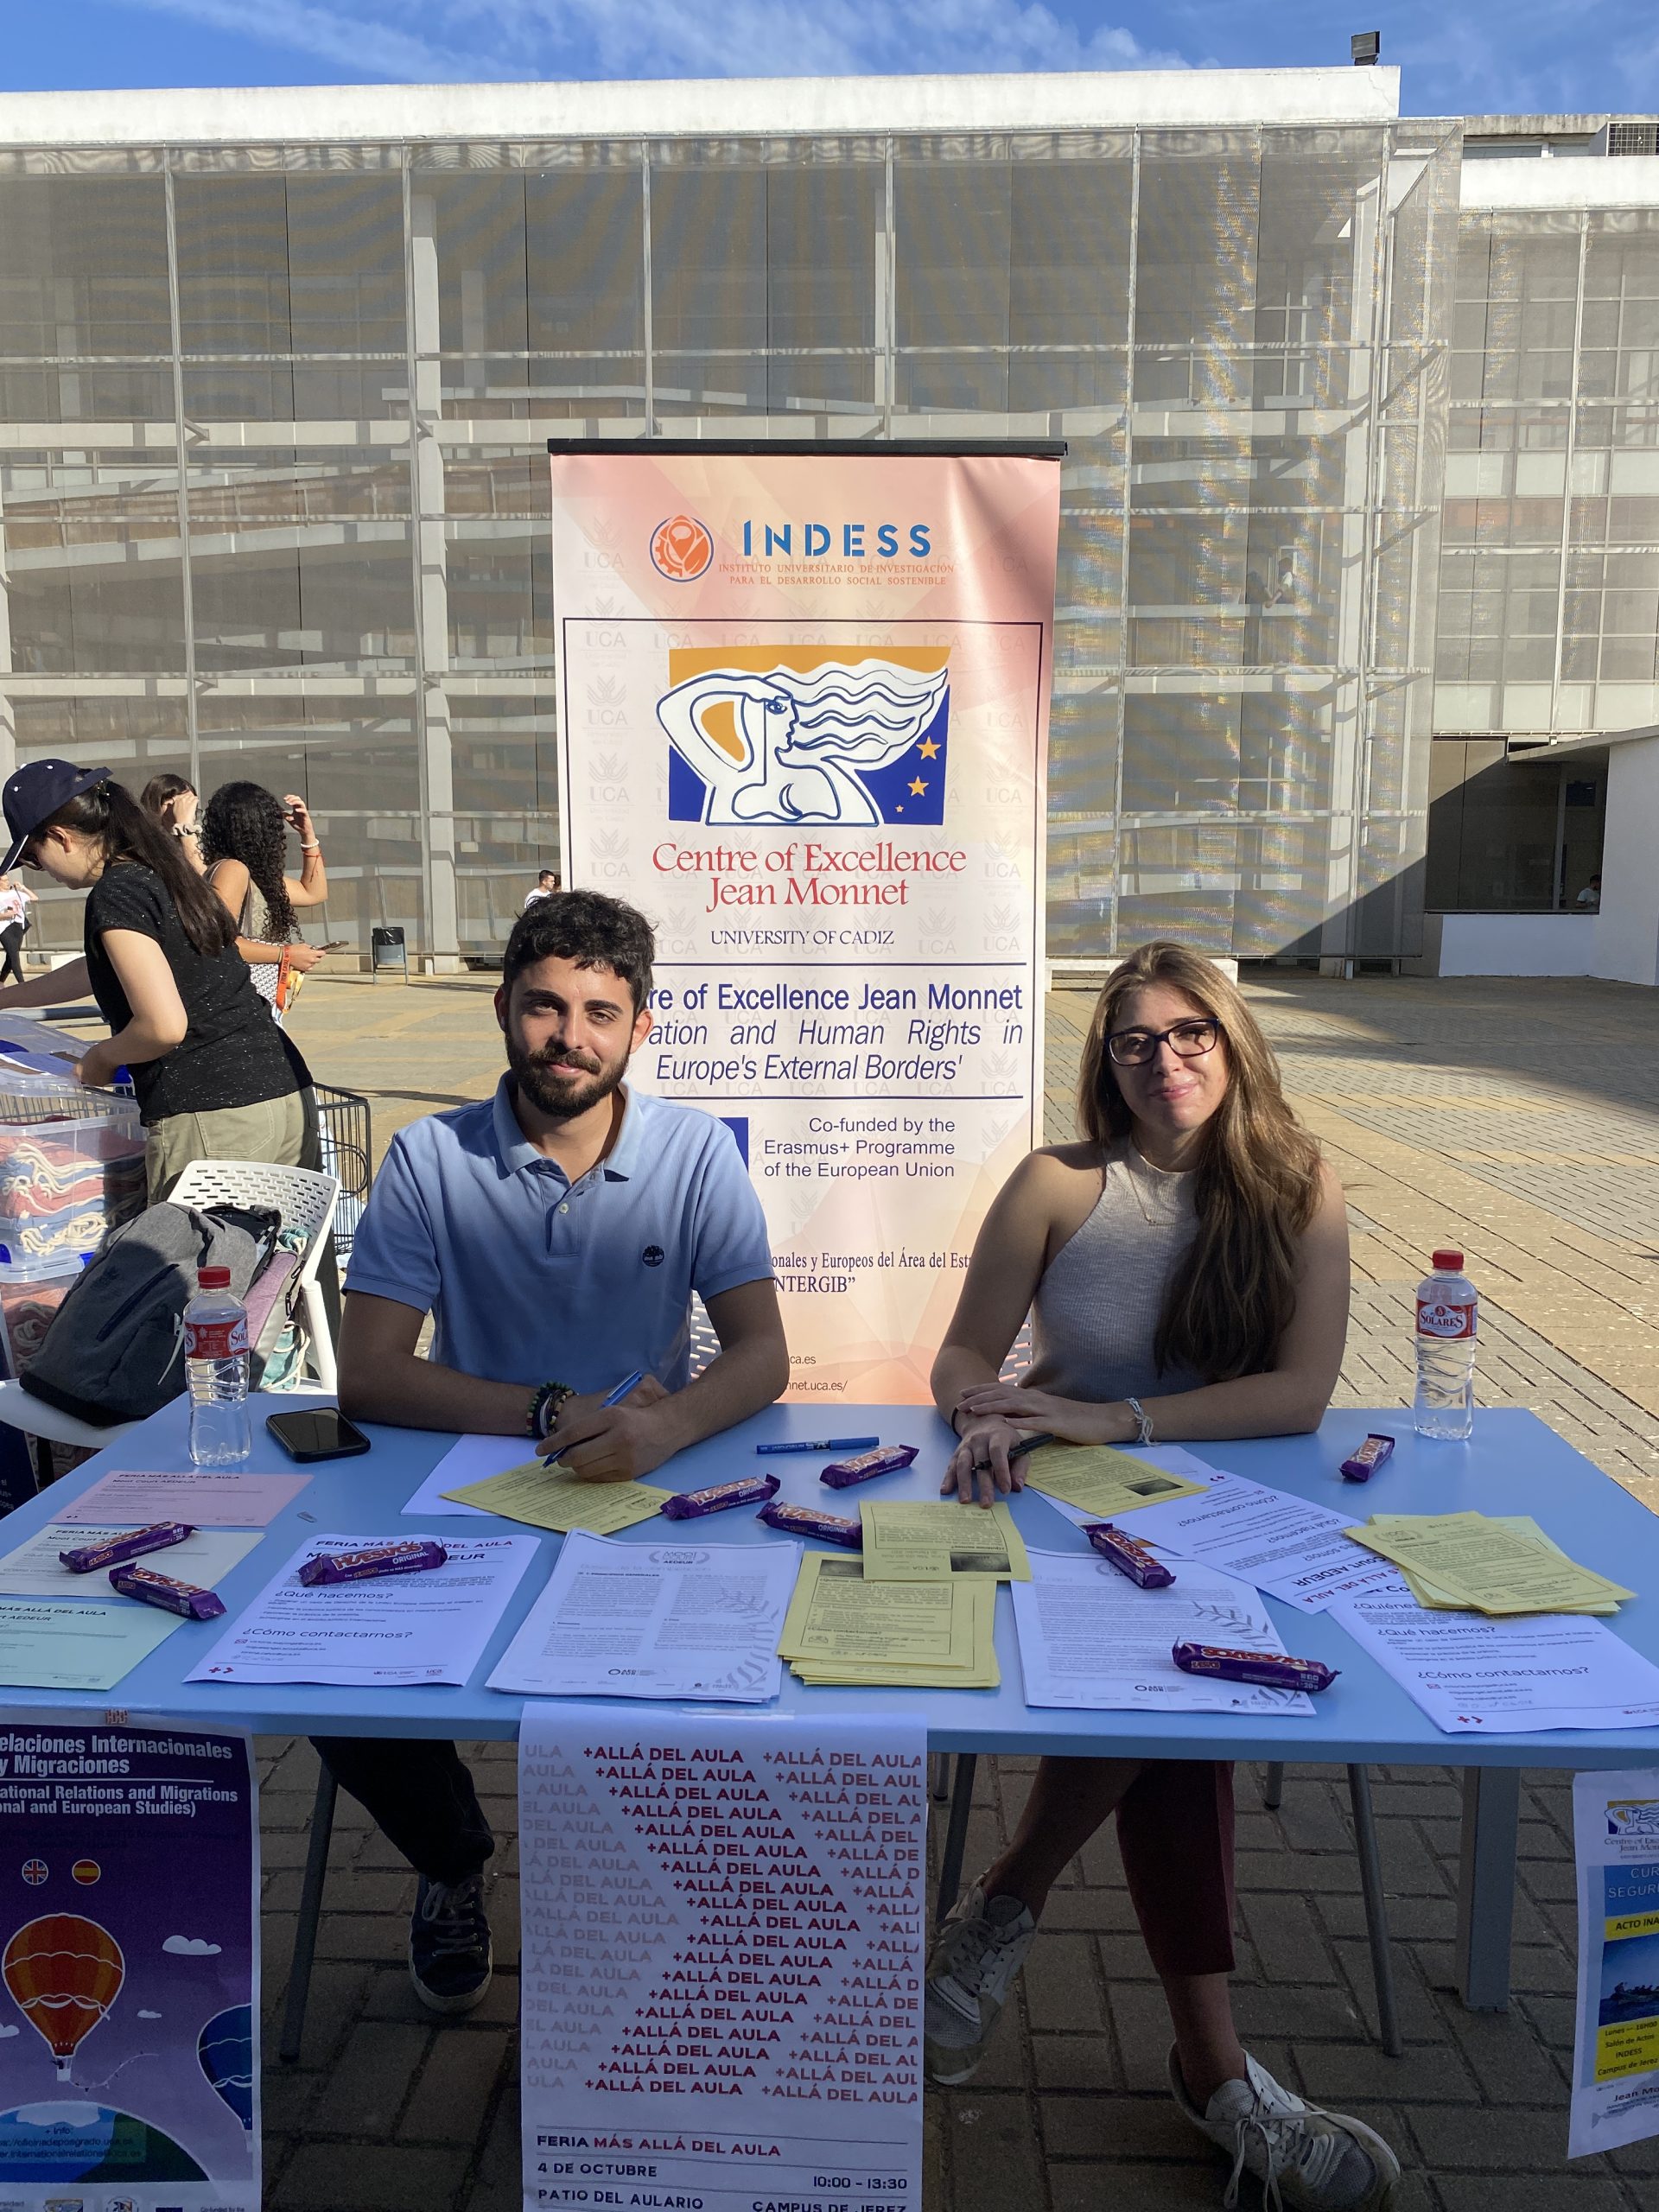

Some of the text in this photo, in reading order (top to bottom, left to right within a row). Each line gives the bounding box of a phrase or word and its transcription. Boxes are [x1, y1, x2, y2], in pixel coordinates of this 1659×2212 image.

[742, 520, 931, 558] INDESS
[719, 563, 955, 573] INSTITUTO UNIVERSITARIO DE INVESTIGACIÓN
[729, 575, 946, 585] PARA EL DESARROLLO SOCIAL SOSTENIBLE
[652, 842, 967, 873] Centre of Excellence
[706, 877, 910, 912] Jean Monnet
[710, 930, 894, 945] UNIVERSITY OF CADIZ
[683, 983, 708, 1010] of
[718, 983, 849, 1011] Excellence
[858, 983, 917, 1011] Jean
[928, 983, 1022, 1011] Monnet
[648, 1020, 1023, 1052] ation and Human Rights in
[657, 1054, 963, 1085] Europe's External Borders'
[809, 1117, 956, 1135] Co-funded by the
[765, 1140, 956, 1158] Erasmus+ Programme
[765, 1161, 955, 1179] of the European Union
[771, 1253, 807, 1268] onales
[810, 1256, 817, 1272] y
[822, 1253, 873, 1271] Europeos
[877, 1252, 894, 1268] del
[899, 1247, 925, 1268] Área
[929, 1252, 946, 1268] del
[774, 1276, 855, 1294] NTERGIB”
[1421, 1311, 1464, 1328] SOLARES
[789, 1355, 816, 1365] ca.es
[787, 1380, 848, 1393] nnet.uca.es/
[363, 1539, 395, 1548] MÁS
[475, 1540, 512, 1548] AULA
[393, 1551, 429, 1564] ORIGINAL
[1292, 1565, 1349, 1586] AEDEUR
[275, 1590, 394, 1599] ¿Qué hacemos?
[1335, 1580, 1356, 1591] DEL
[1302, 1589, 1334, 1604] AULA
[243, 1628, 413, 1639] ¿Cómo contactarnos?
[1420, 1626, 1496, 1636] hacemos?
[1418, 1667, 1589, 1680] ¿Cómo contactarnos?
[0, 1733, 232, 1759] elaciones Internacionales
[584, 1742, 743, 1763] +ALLÁ DEL AULA
[14, 1756, 130, 1777] Migraciones
[0, 1786, 238, 1802] ational Relations and Migrations
[30, 1801, 196, 1817] and European Studies)
[621, 1801, 780, 1821] +ALLÁ DEL AULA
[660, 1857, 819, 1878] +ALLÁ DEL AULA
[700, 1911, 859, 1932] +ALLÁ DEL AULA
[1616, 1920, 1640, 1930] ACTO
[662, 1966, 821, 1986] +ALLÁ DEL AULA
[622, 2021, 781, 2042] +ALLÁ DEL AULA
[1616, 2048, 1643, 2058] INDESS
[1598, 2063, 1626, 2075] Campus
[585, 2075, 744, 2096] +ALLÁ DEL AULA
[1614, 2090, 1638, 2101] Jean
[537, 2133, 781, 2158] FERIA MÁS ALLÁ DEL AULA
[537, 2162, 907, 2190] 4 DE OCTUBRE 10:00 13:30
[538, 2189, 588, 2202] PATIO
[594, 2190, 624, 2205] DEL
[630, 2193, 703, 2209] AULARIO
